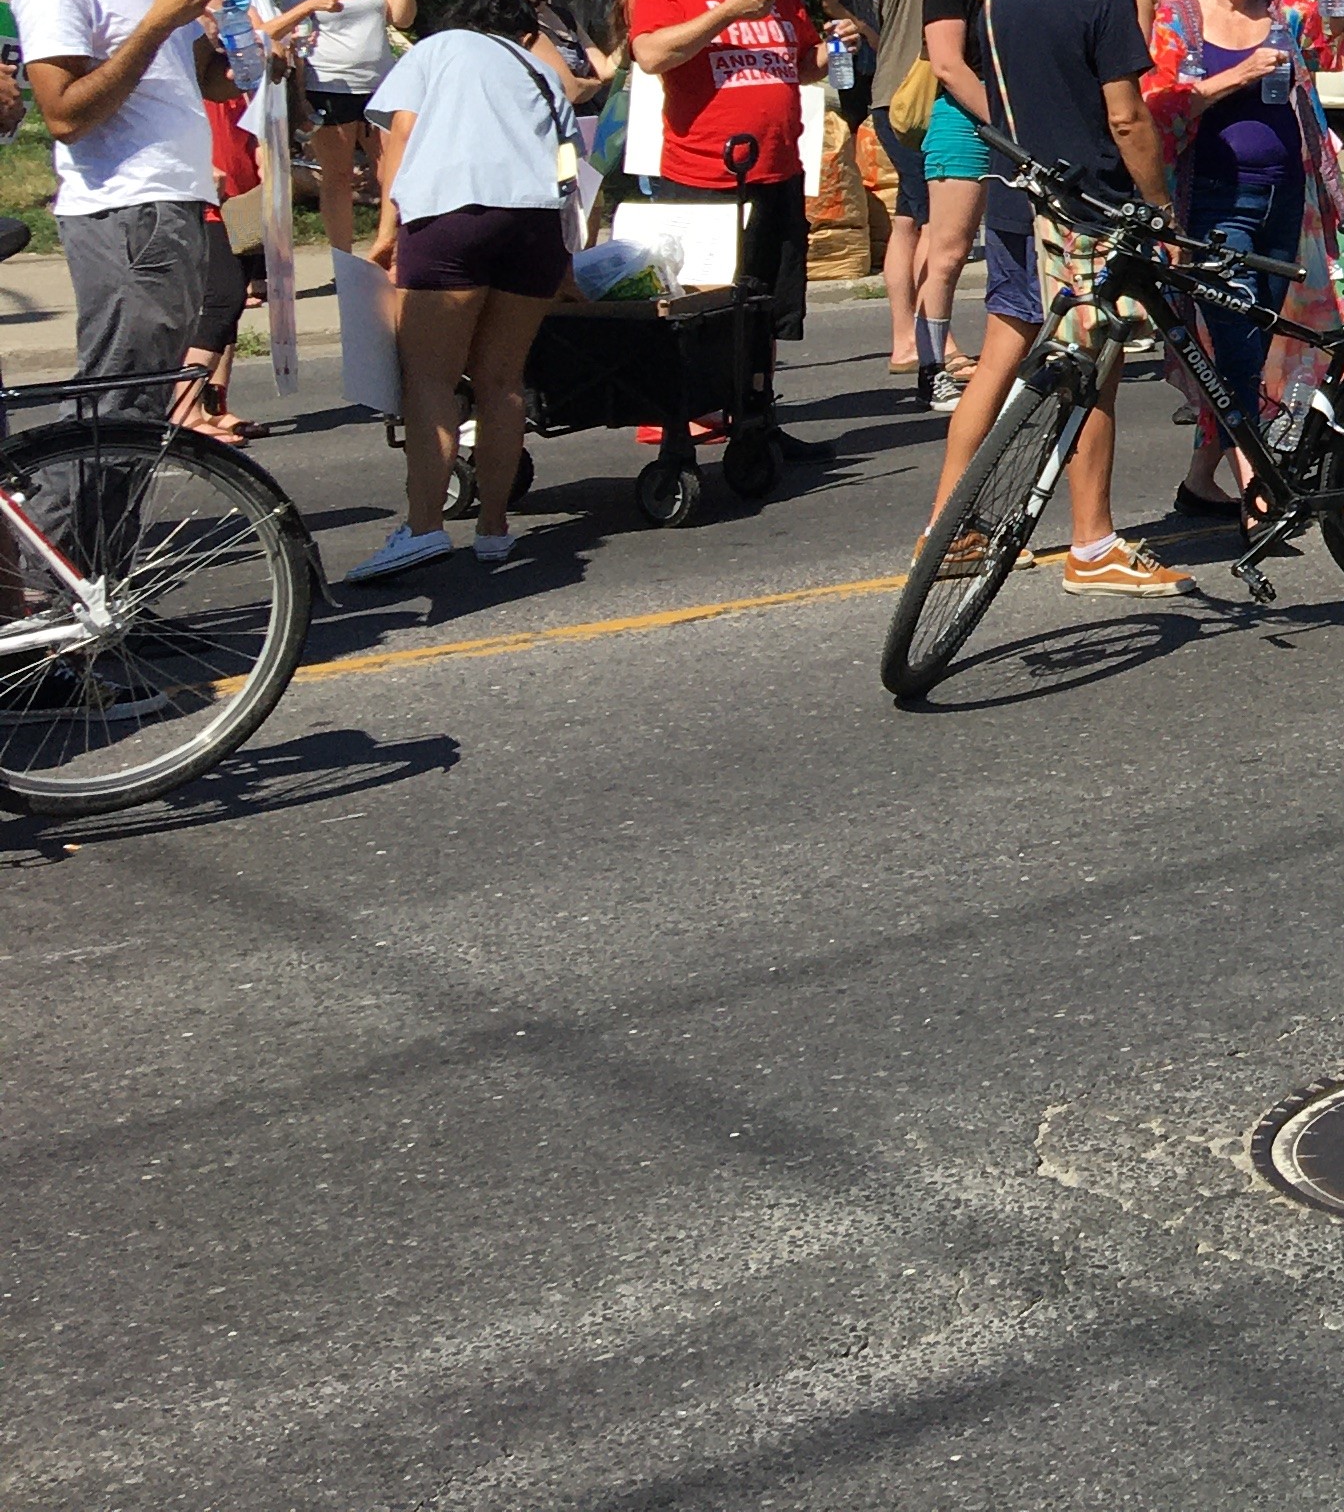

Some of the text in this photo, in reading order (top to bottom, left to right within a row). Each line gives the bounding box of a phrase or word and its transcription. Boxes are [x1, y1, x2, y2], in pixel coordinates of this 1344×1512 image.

[715, 54, 757, 69] AND
[723, 66, 797, 83] TALKING
[1192, 284, 1251, 315] POLICE
[1182, 341, 1230, 409] TORONTO
